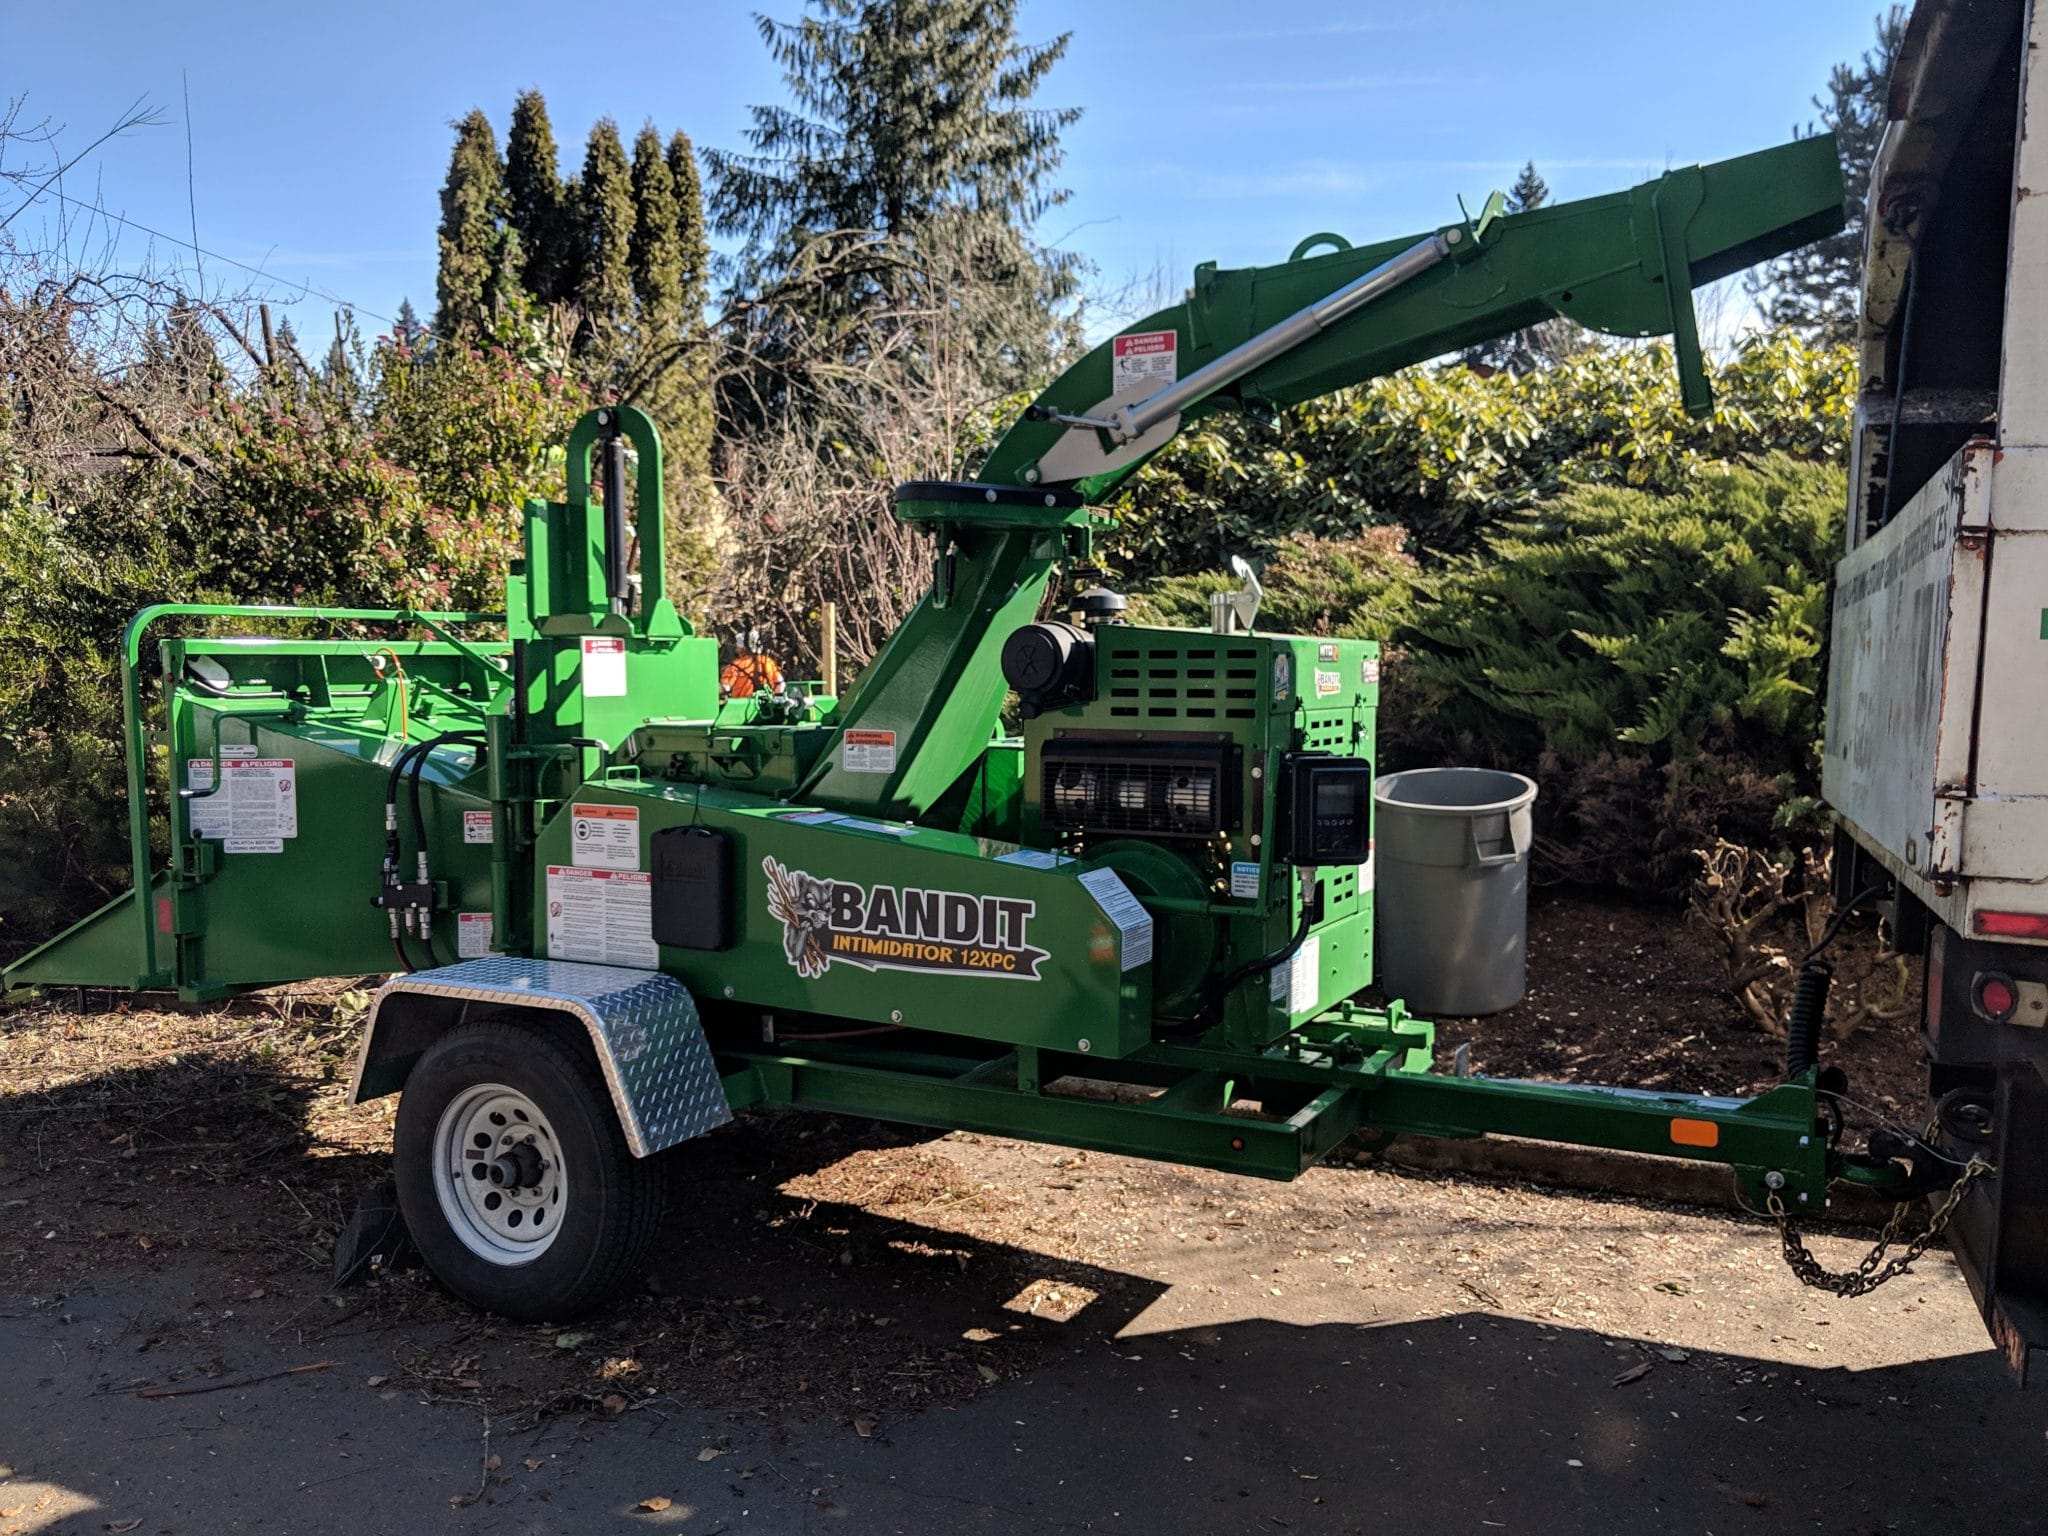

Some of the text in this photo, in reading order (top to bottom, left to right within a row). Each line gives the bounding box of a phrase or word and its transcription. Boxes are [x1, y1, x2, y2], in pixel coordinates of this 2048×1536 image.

[566, 869, 593, 877] DANGER
[618, 873, 648, 881] PELIGRO
[831, 883, 1033, 948] BANDIT
[833, 934, 1016, 971] INTIMIDATOR 12XPC
